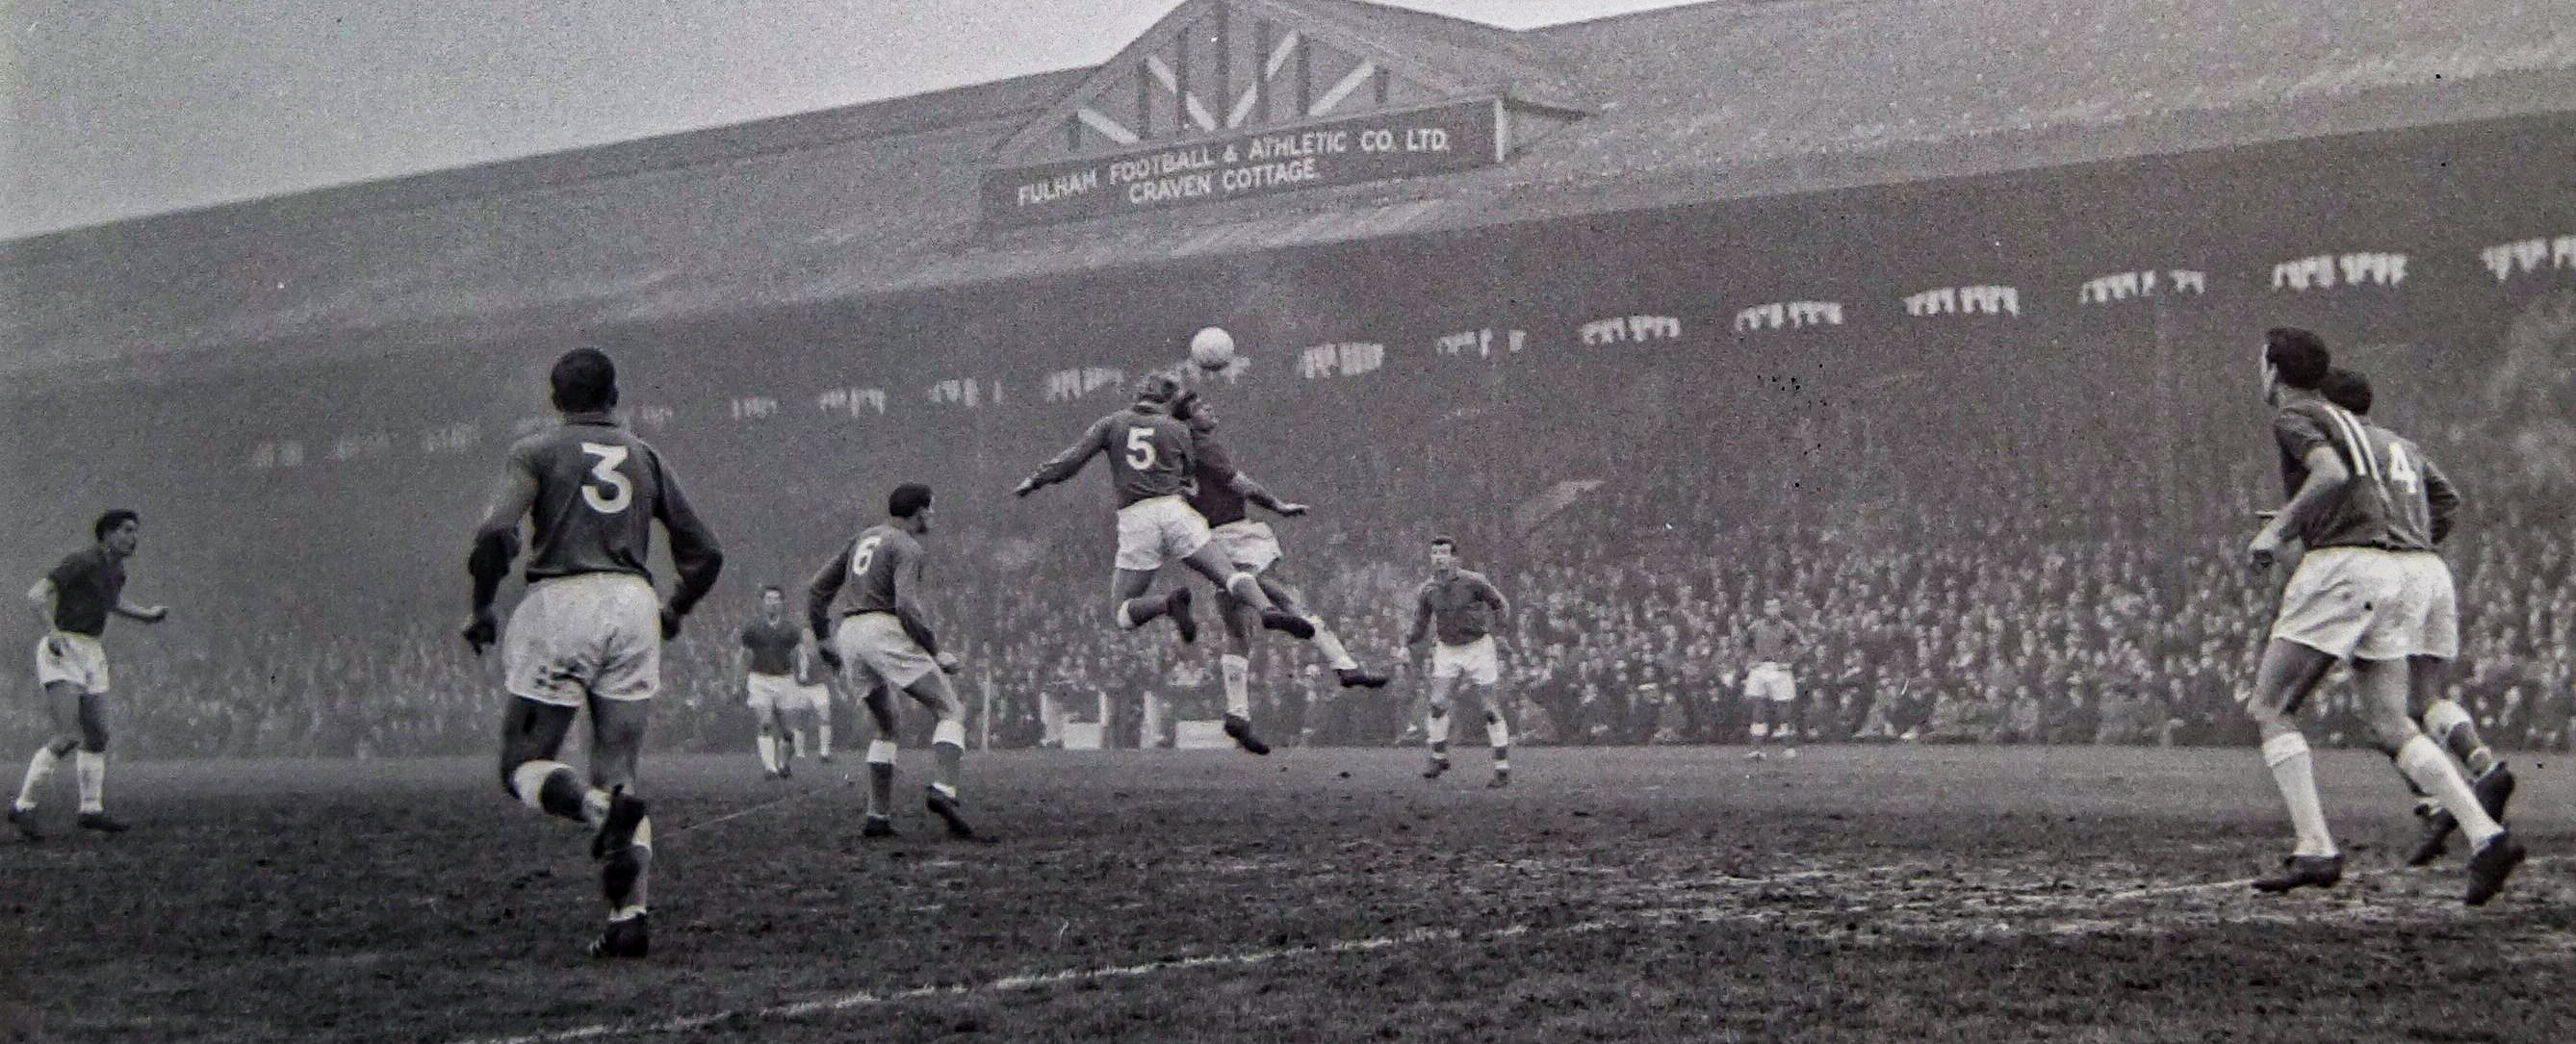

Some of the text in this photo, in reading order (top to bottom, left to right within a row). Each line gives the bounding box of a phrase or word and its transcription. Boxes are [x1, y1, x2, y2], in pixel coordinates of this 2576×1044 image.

[1018, 168, 1097, 206] FULHAM
[1109, 148, 1215, 186] FOOTBALL
[1223, 144, 1239, 163] &
[1249, 130, 1347, 160] ATHLETIC
[1129, 175, 1211, 204] CRAVEN
[1125, 427, 1155, 470] 5
[2387, 442, 2417, 494] 4
[581, 442, 631, 513] 3
[853, 535, 882, 575] 6
